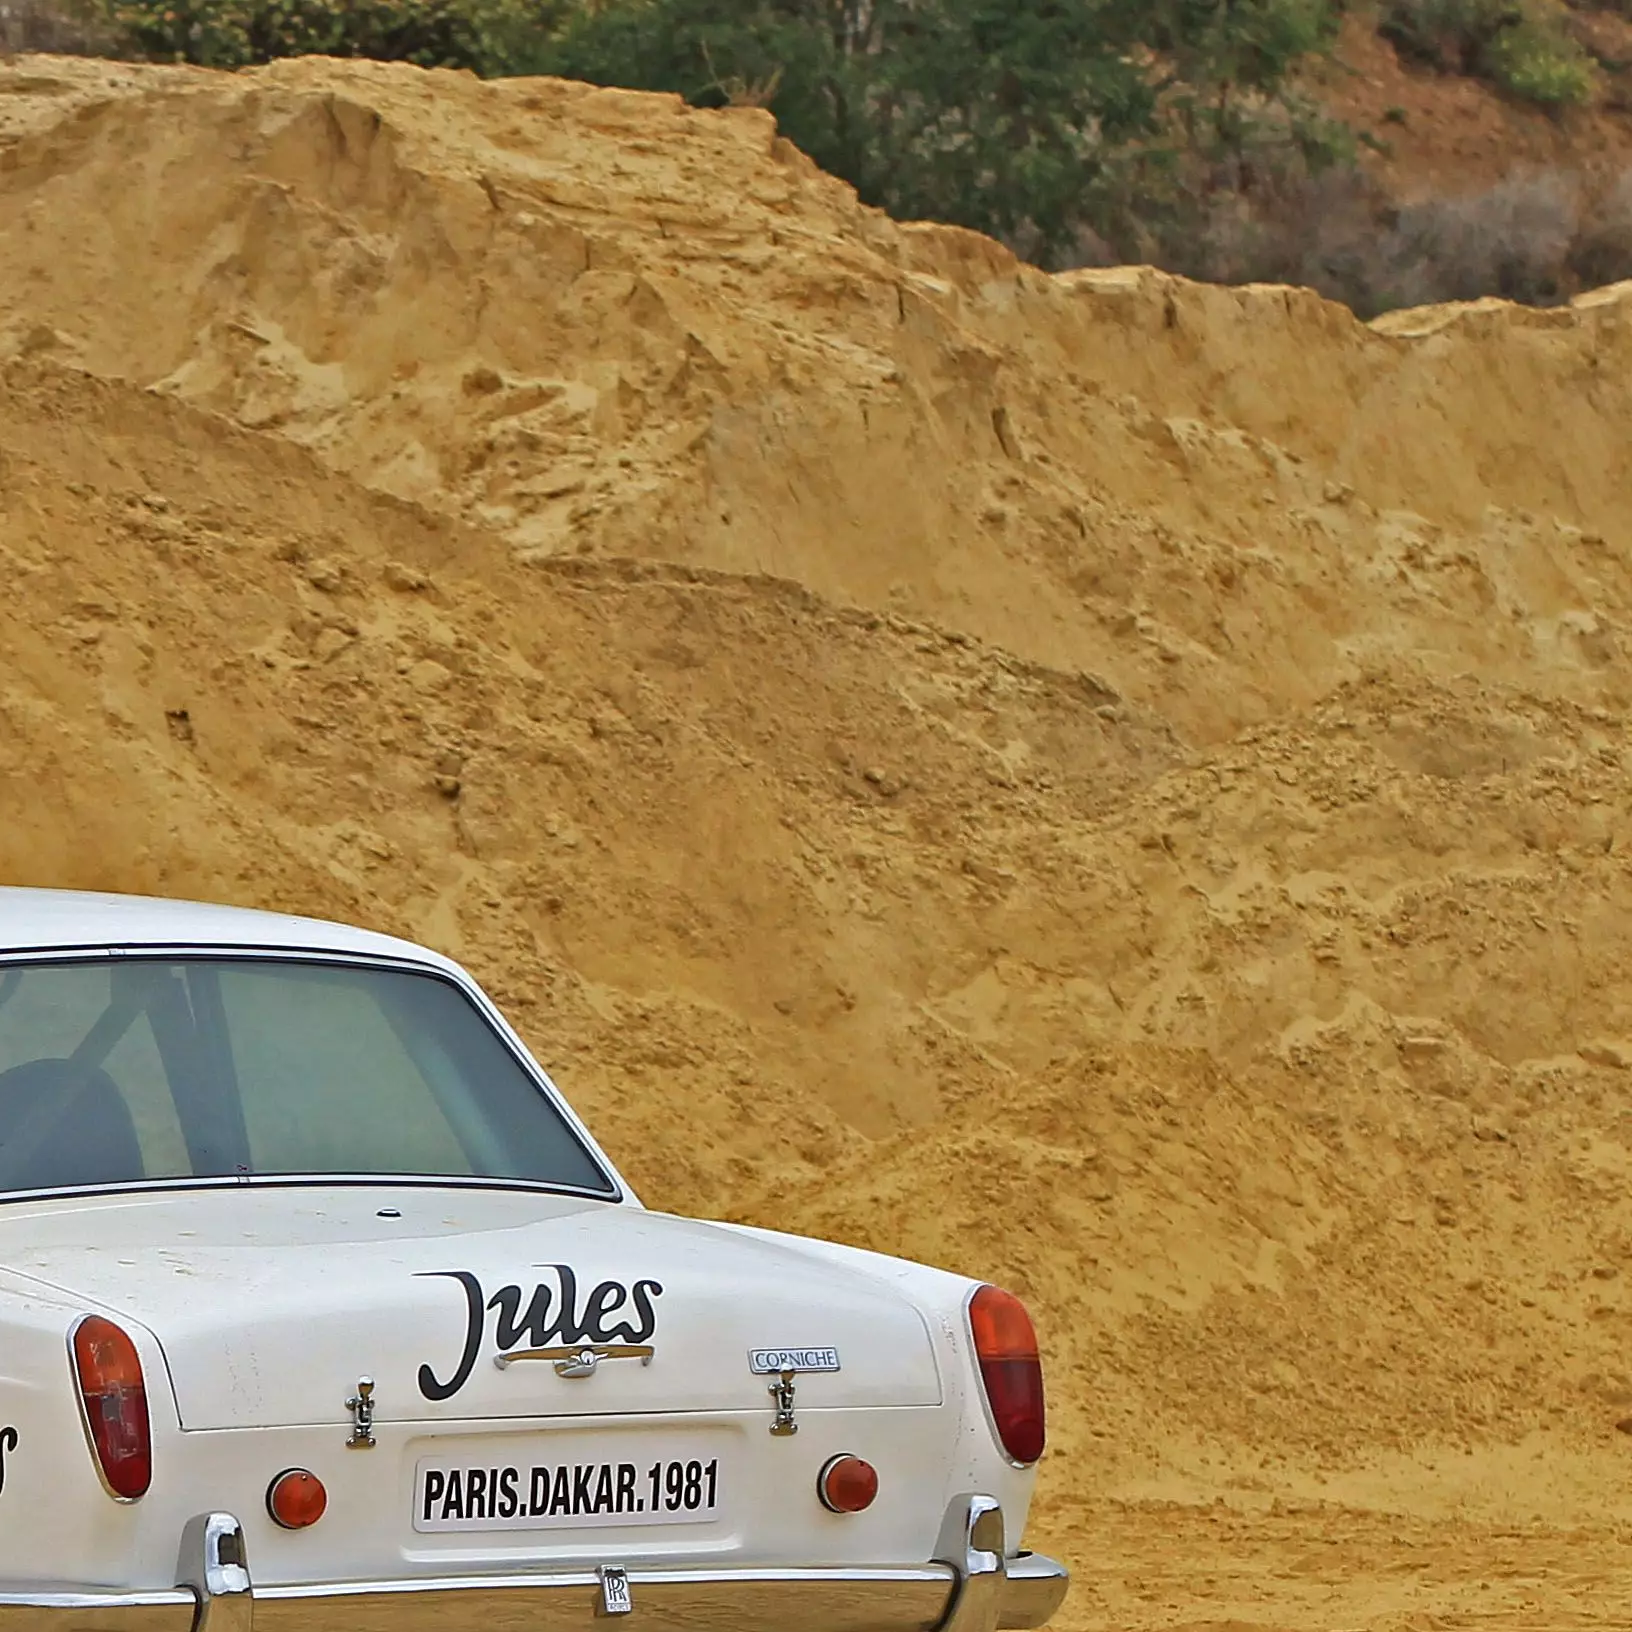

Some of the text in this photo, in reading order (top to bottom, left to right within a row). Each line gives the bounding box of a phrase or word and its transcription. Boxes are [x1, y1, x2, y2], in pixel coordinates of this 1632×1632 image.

[412, 1263, 664, 1401] Jules
[755, 1350, 836, 1368] CORNICHE
[422, 1458, 720, 1522] PARIS.DAKAR.1981
